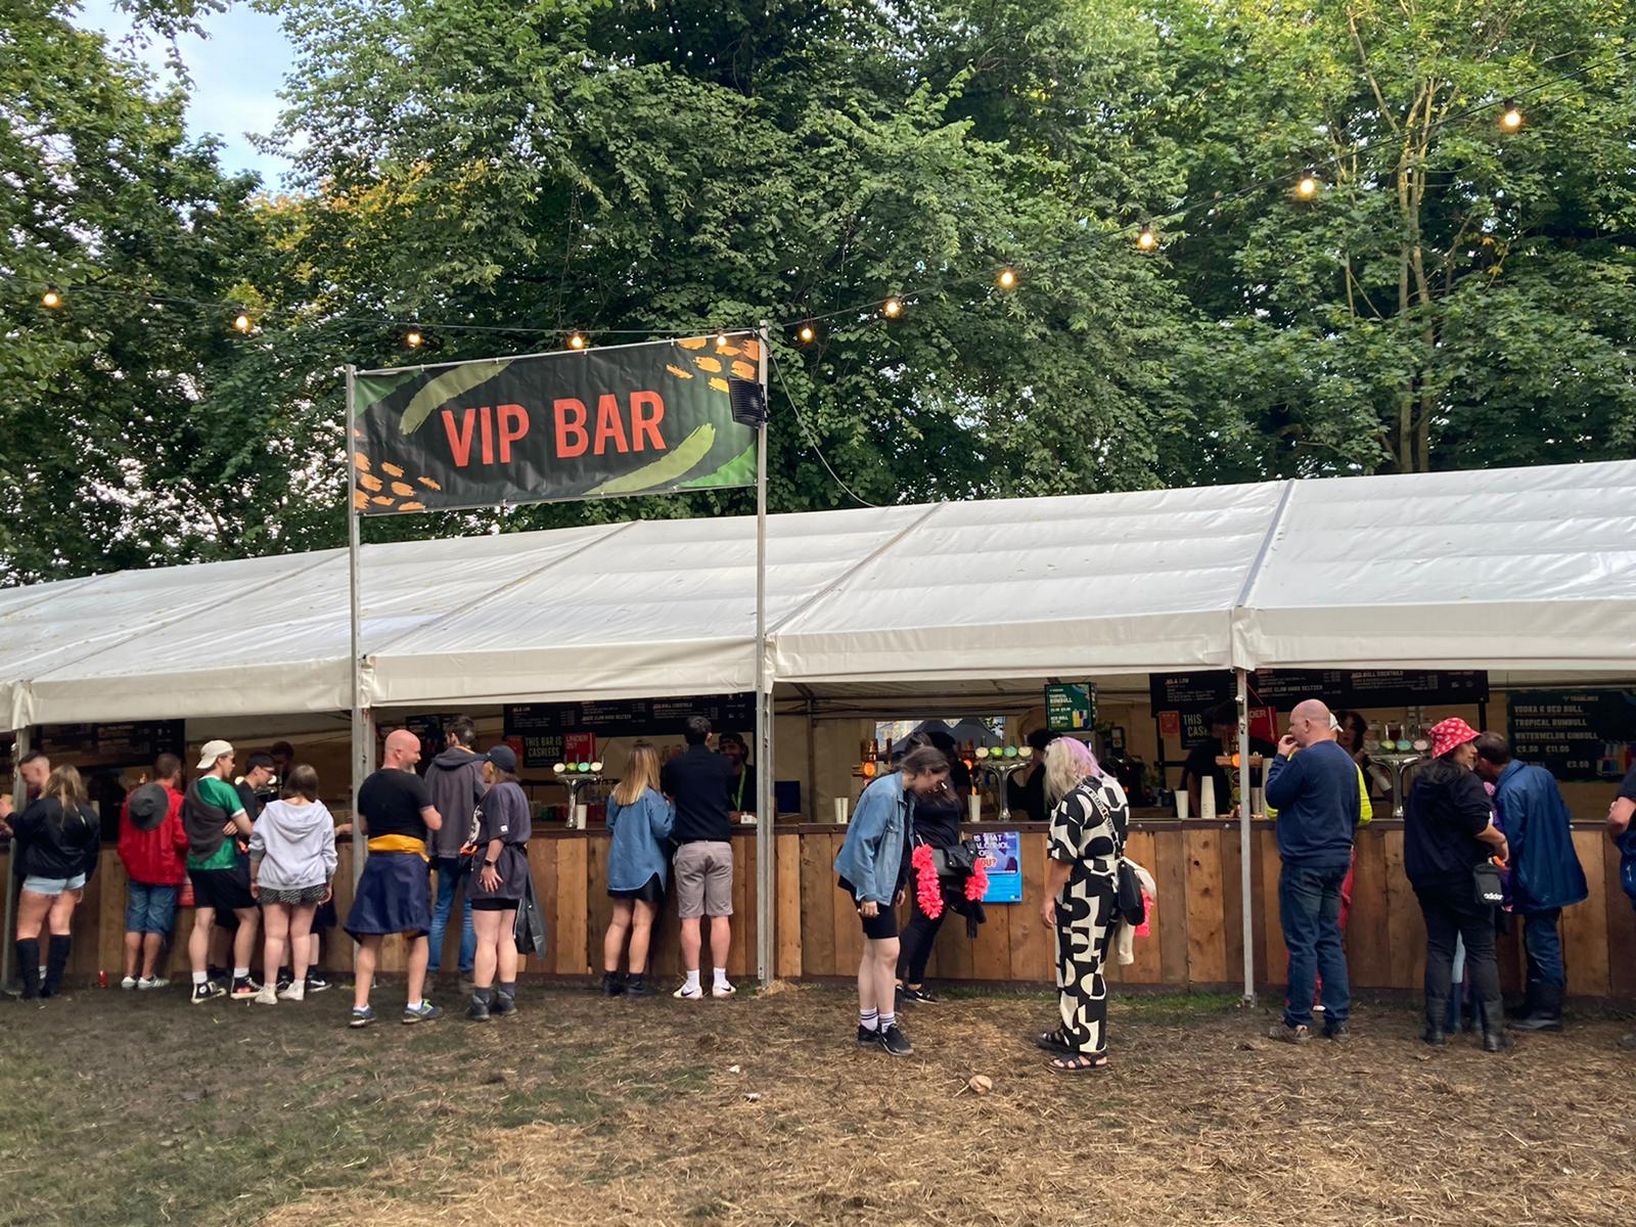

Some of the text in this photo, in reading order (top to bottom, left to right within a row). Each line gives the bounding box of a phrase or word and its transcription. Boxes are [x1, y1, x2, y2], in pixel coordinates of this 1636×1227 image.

[442, 391, 667, 467] VIP BAR
[1513, 705, 1538, 713] VODKA
[1184, 713, 1202, 726] THIS
[1515, 718, 1587, 727] TROPICAL RUMBULL
[1514, 732, 1565, 740] WATERMELON
[525, 736, 562, 746] THIS BAR IS
[528, 746, 560, 758] CASHLESS
[983, 833, 1003, 842] THAT
